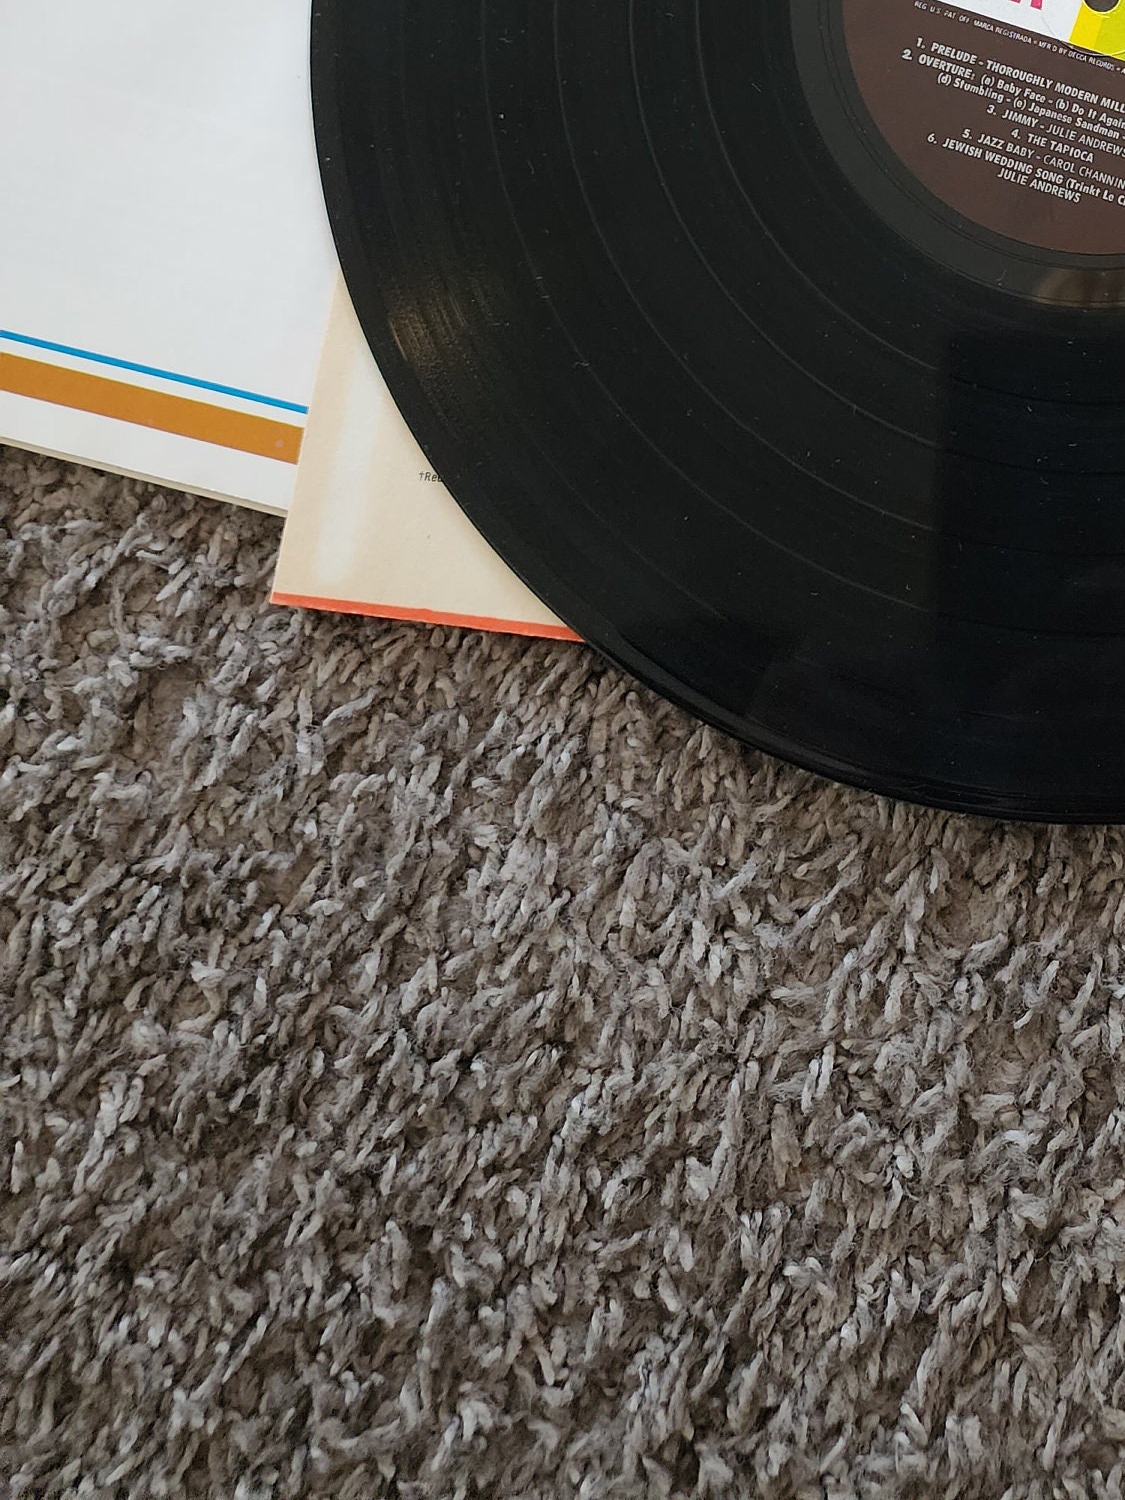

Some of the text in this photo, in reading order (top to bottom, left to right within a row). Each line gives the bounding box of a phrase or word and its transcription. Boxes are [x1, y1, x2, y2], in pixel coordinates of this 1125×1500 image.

[995, 26, 1032, 44] REGISTRADA
[931, 42, 978, 65] PRELUDE
[986, 60, 1053, 89] THOROUGHLY
[1055, 82, 1099, 104] MODERN
[937, 72, 951, 86] (d)
[953, 78, 1005, 103] Stumbling
[1013, 97, 1027, 110] (e)
[1028, 102, 1073, 124] Japanese
[1075, 117, 1120, 140] Sandman
[980, 74, 995, 87] (a)
[997, 79, 1022, 96] Baby
[1023, 88, 1046, 103] Face
[1055, 98, 1070, 111] (b)
[1071, 102, 1085, 116] Do
[1001, 109, 1039, 129] JIMMY
[1046, 124, 1077, 141] JULIE
[977, 133, 1005, 150] JAZZ
[1005, 142, 1035, 160] BABY
[1043, 155, 1076, 174] CAROL
[1027, 133, 1094, 163] THE TAPIOCA
[942, 138, 983, 158] JEWISH
[984, 150, 1033, 174] WEDDING
[1035, 167, 1064, 184] SONG
[1065, 177, 1101, 197] (Trinkt
[1102, 189, 1115, 202] Le
[997, 168, 1082, 204] JULIE ANDREWS
